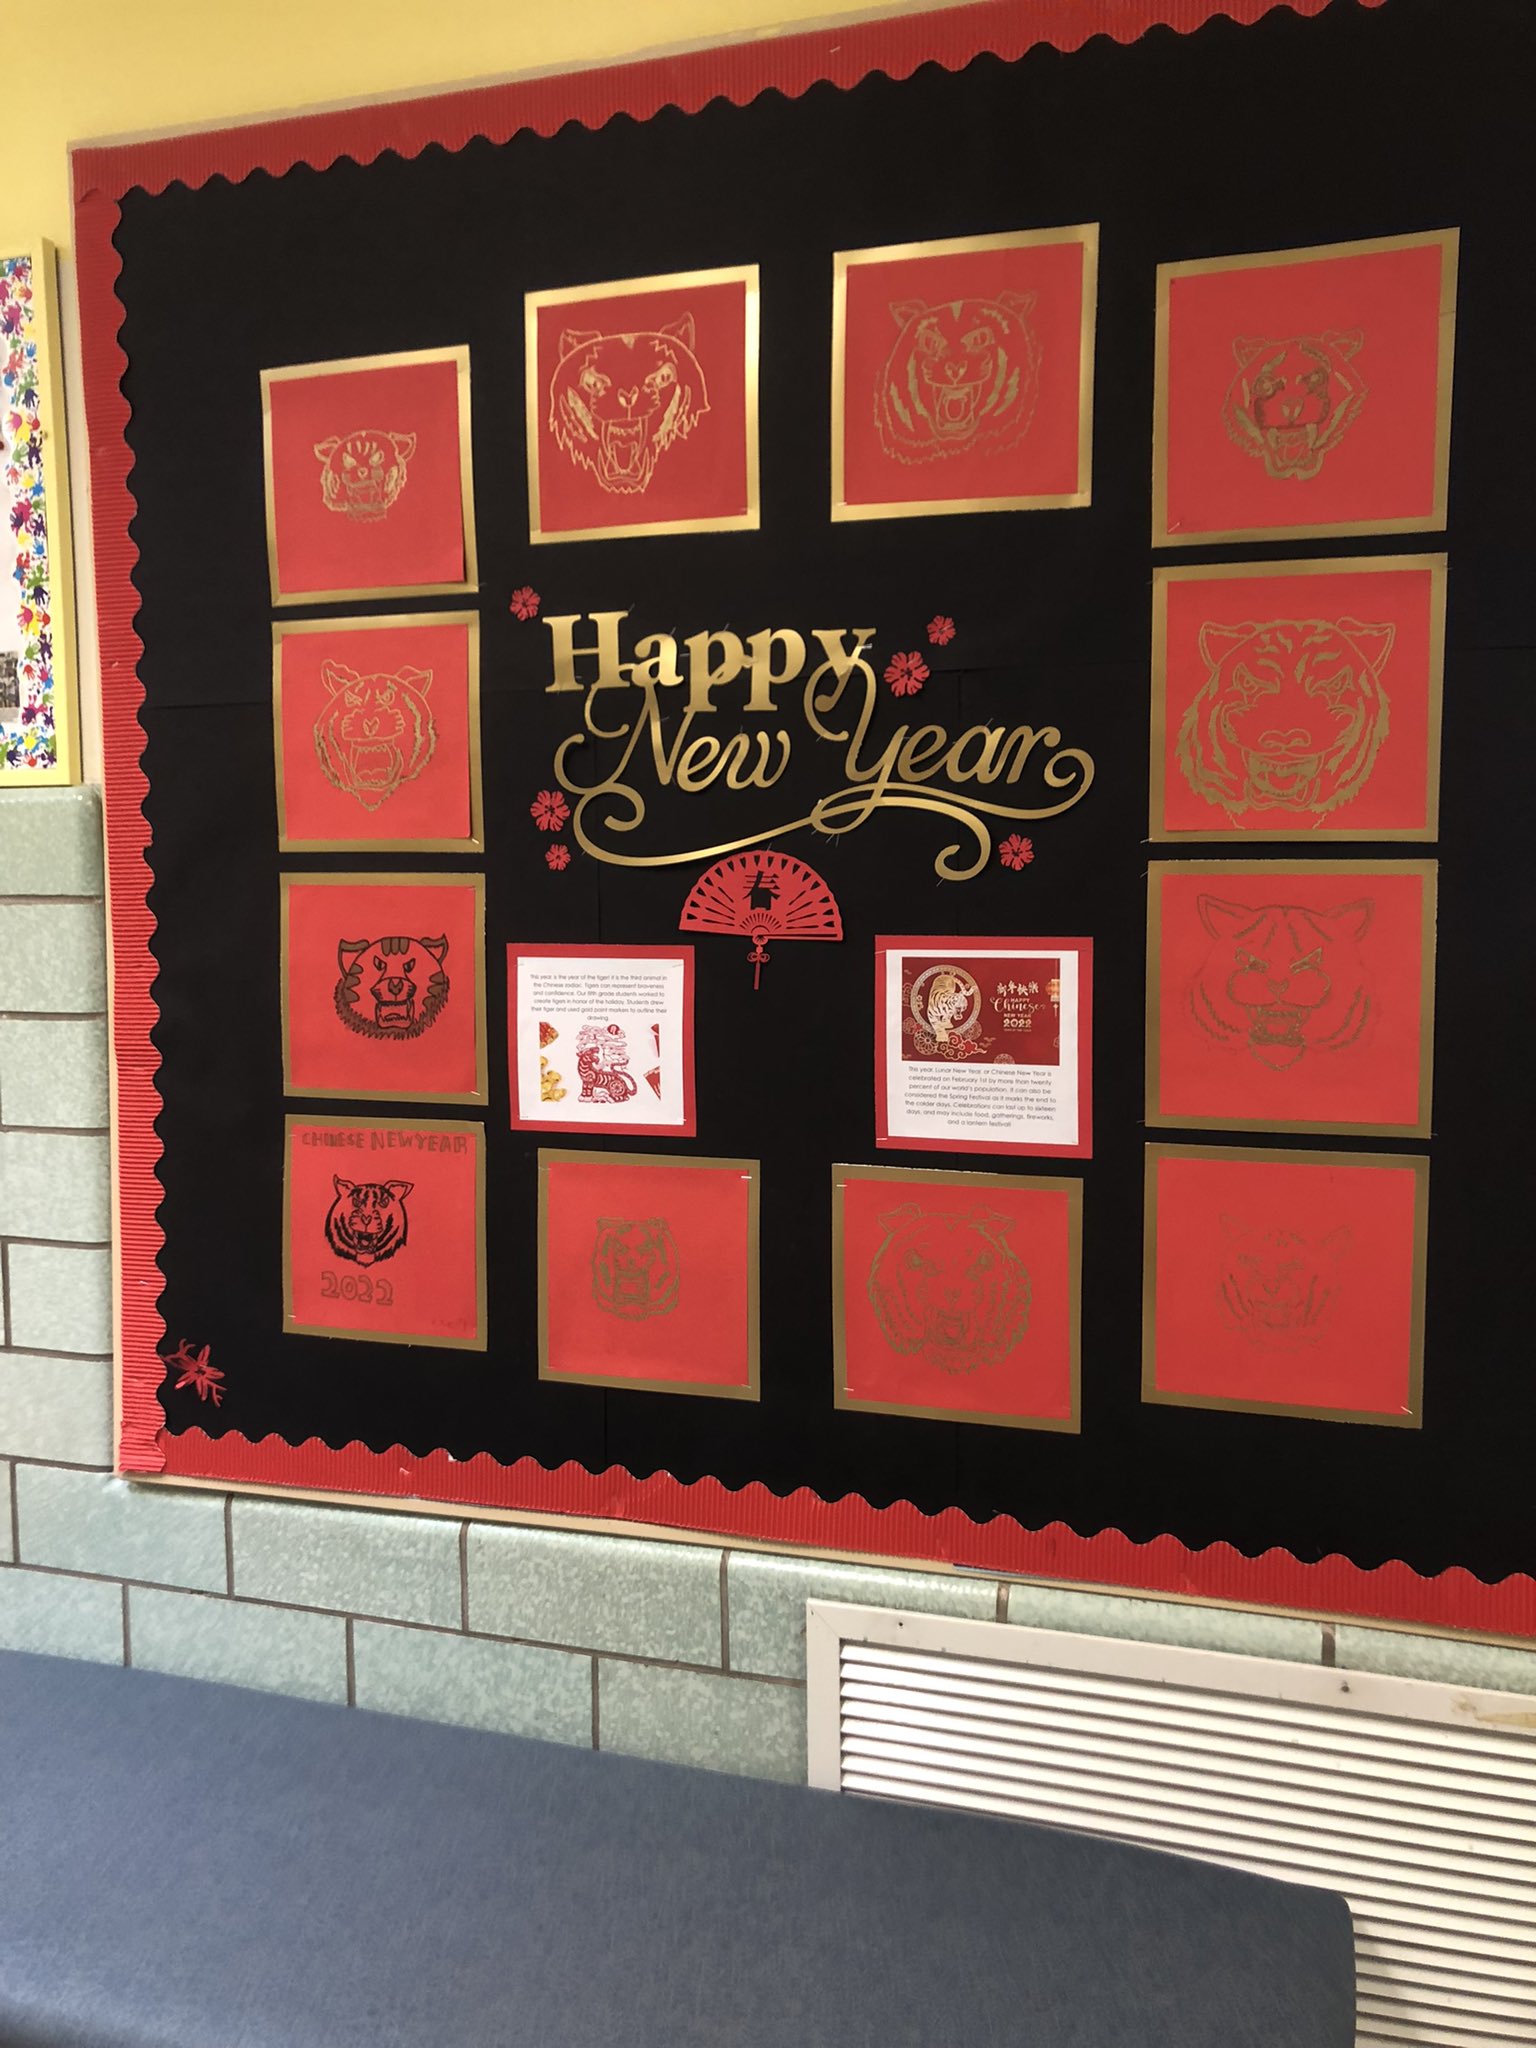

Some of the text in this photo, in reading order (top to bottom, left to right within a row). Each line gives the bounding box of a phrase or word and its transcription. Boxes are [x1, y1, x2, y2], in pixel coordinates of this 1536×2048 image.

[542, 611, 876, 711] Happy
[803, 658, 1095, 835] Year
[743, 870, 781, 911] 春
[990, 998, 1046, 1014] Chinese
[1003, 1018, 1032, 1028] 2022
[320, 1270, 394, 1306] 2022
